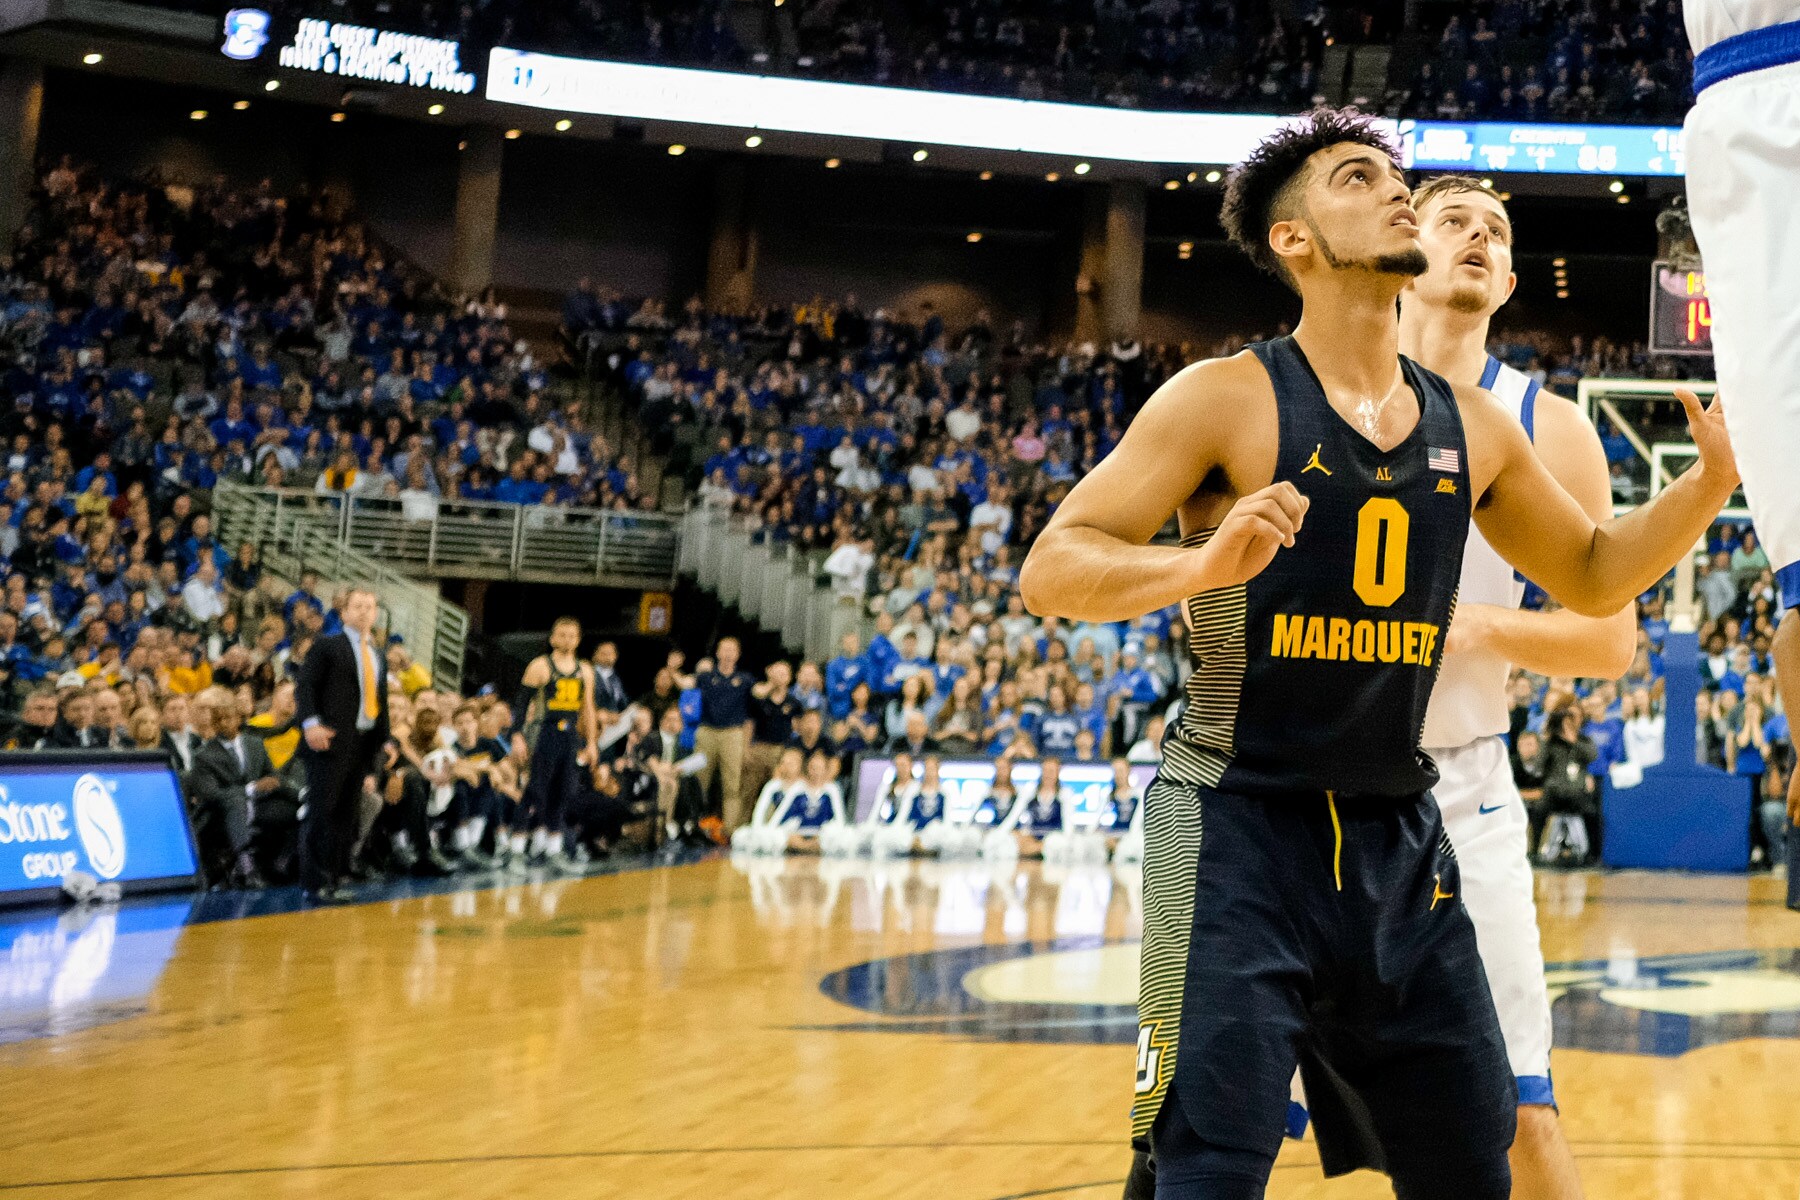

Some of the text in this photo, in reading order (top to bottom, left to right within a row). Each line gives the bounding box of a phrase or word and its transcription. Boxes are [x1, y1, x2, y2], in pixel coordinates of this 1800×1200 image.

[1375, 467, 1393, 481] AL
[1353, 497, 1409, 608] 0
[23, 851, 77, 879] GROUP
